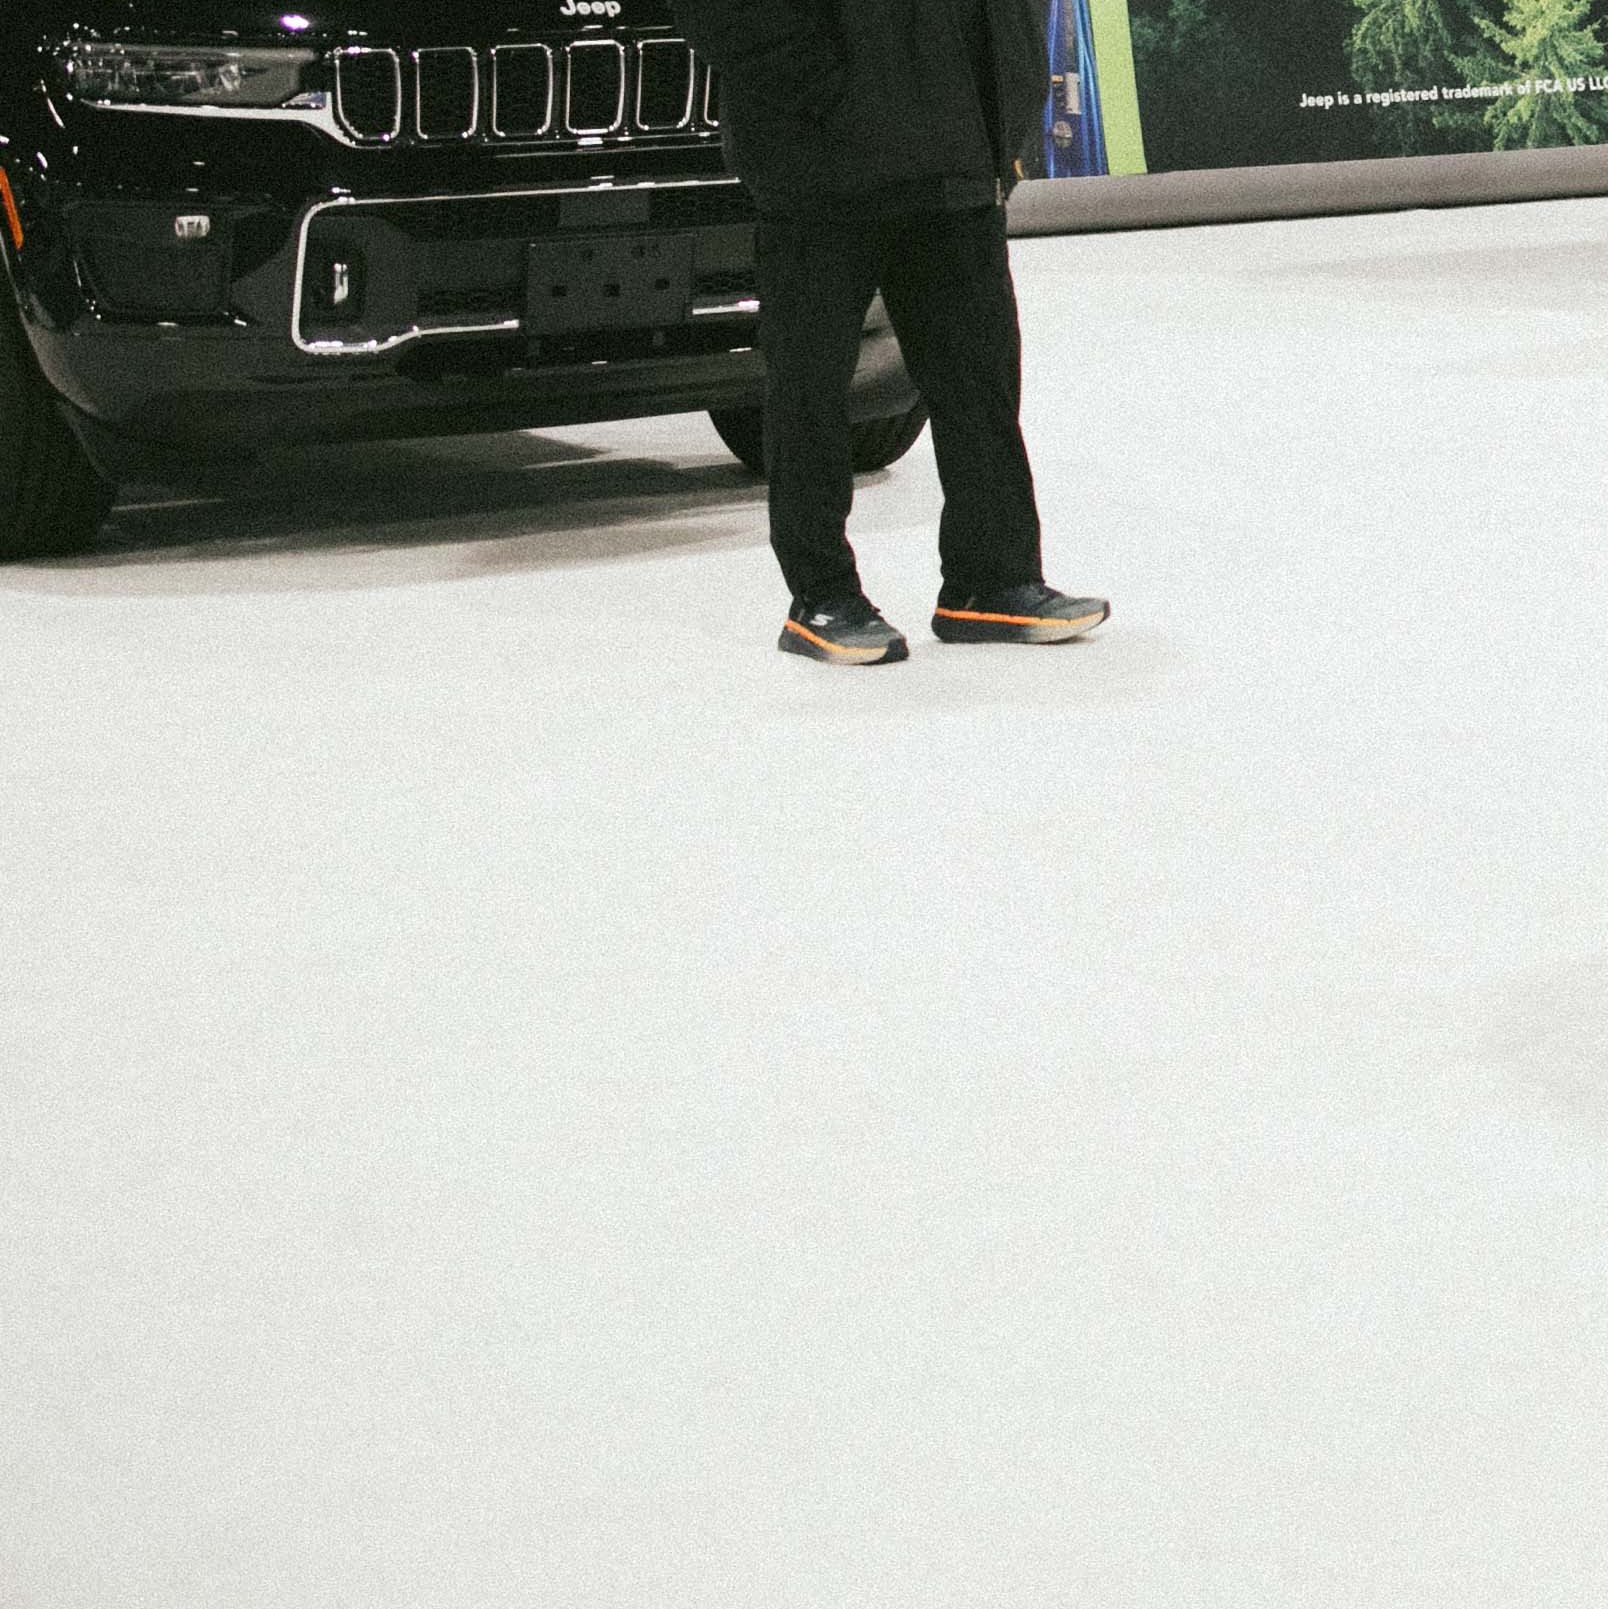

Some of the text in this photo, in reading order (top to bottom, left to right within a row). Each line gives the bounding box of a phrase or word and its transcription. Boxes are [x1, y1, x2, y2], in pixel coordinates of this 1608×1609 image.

[1299, 92, 1334, 110] Jeep
[1337, 91, 1350, 106] is
[1353, 92, 1363, 105] a
[1365, 85, 1439, 107] registered
[1442, 82, 1514, 100] trademark
[1516, 80, 1533, 95] of
[1535, 78, 1564, 94] FCA
[1566, 77, 1586, 92] US
